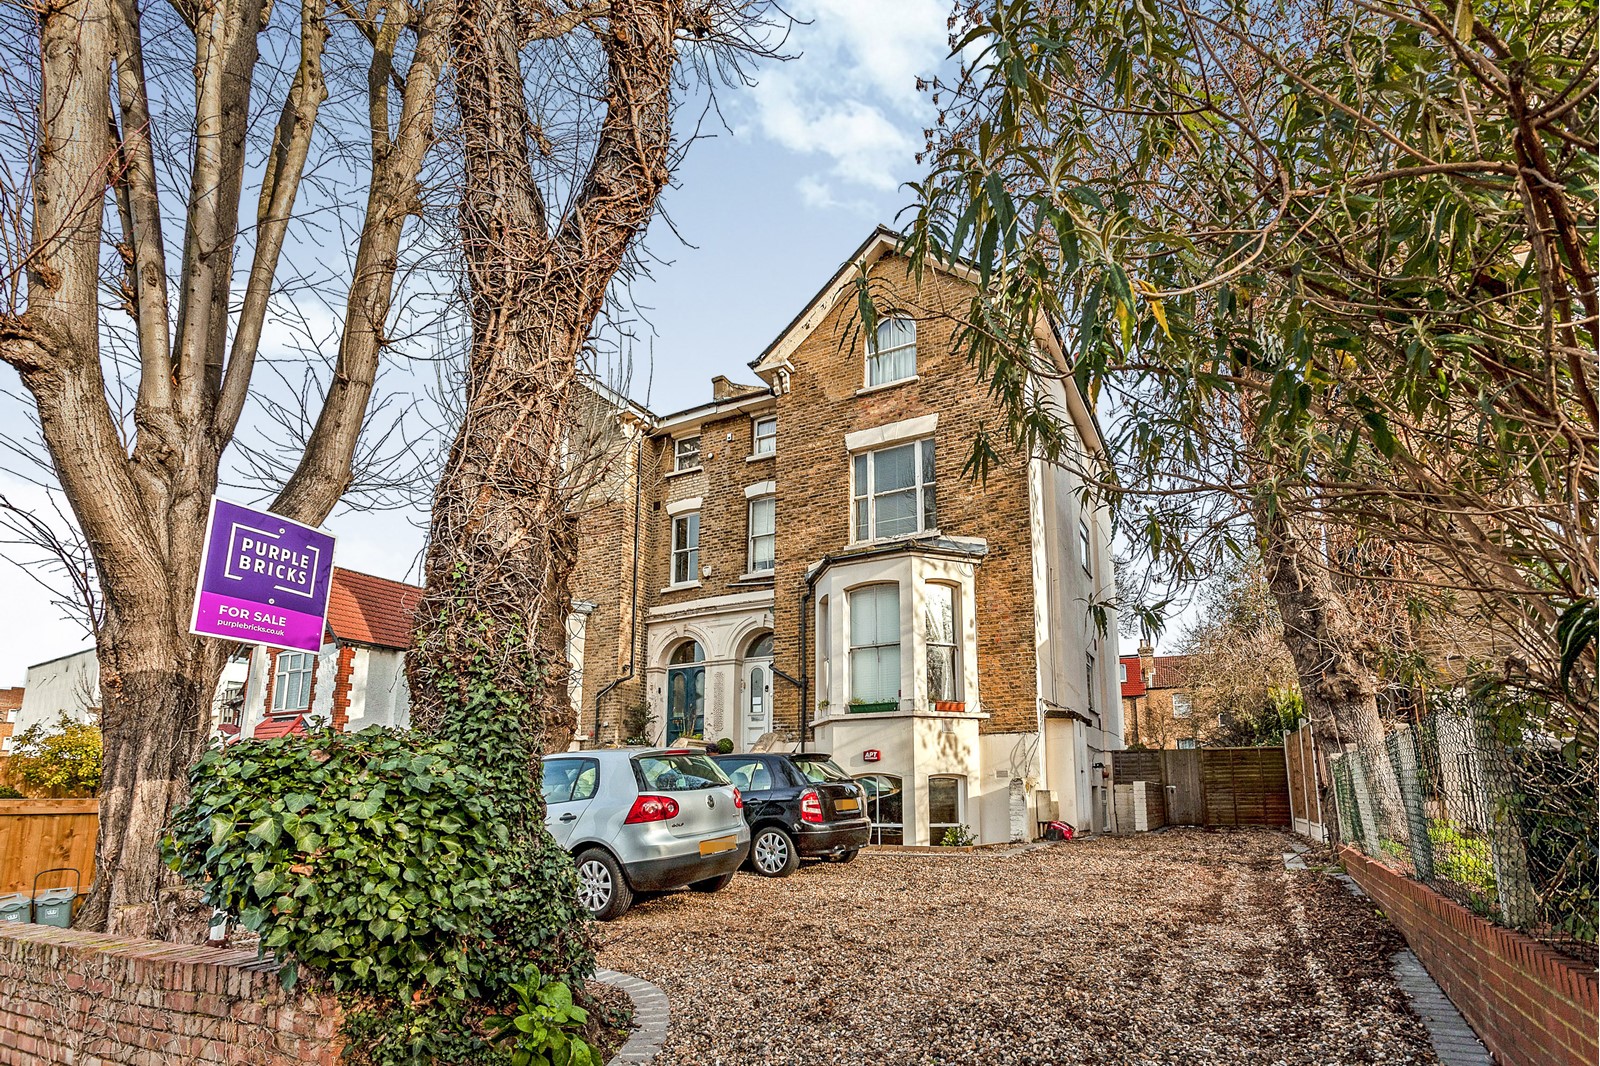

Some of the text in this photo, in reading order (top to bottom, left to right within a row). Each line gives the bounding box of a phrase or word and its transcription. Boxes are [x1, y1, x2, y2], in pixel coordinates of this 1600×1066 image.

[241, 537, 309, 569] PURPLE
[239, 554, 307, 585] BRICKS
[217, 619, 285, 636] purplebricks.co.uk
[218, 604, 287, 627] FOR SALE
